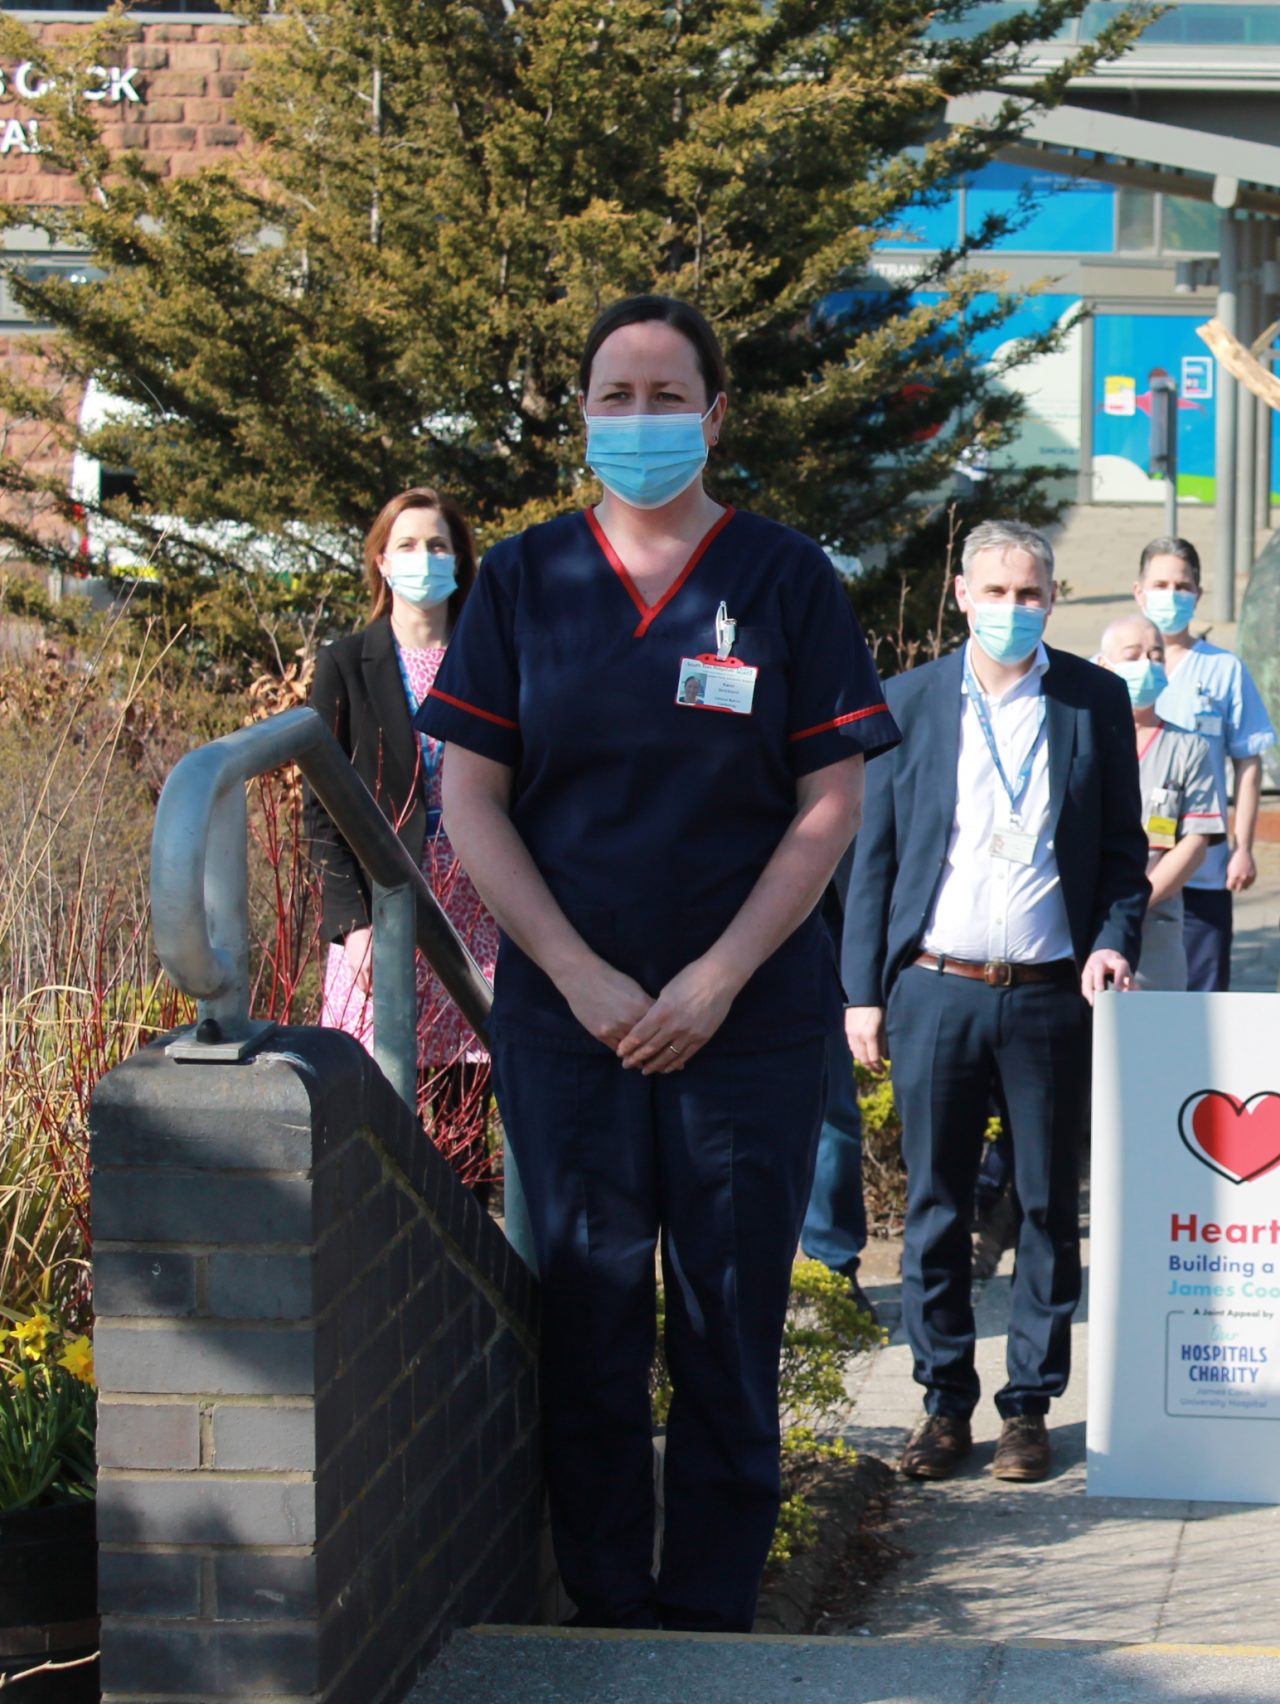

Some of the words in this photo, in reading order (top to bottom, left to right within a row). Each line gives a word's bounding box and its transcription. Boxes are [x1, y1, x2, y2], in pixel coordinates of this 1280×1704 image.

[1169, 1254, 1255, 1278] Building
[1262, 1262, 1274, 1274] a
[1168, 1279, 1235, 1297] James
[1193, 1308, 1200, 1316] A
[1227, 1309, 1260, 1319] Appeal
[1262, 1309, 1274, 1320] by
[1181, 1344, 1268, 1363] HOSPITALS
[1189, 1364, 1259, 1383] CHARITY
